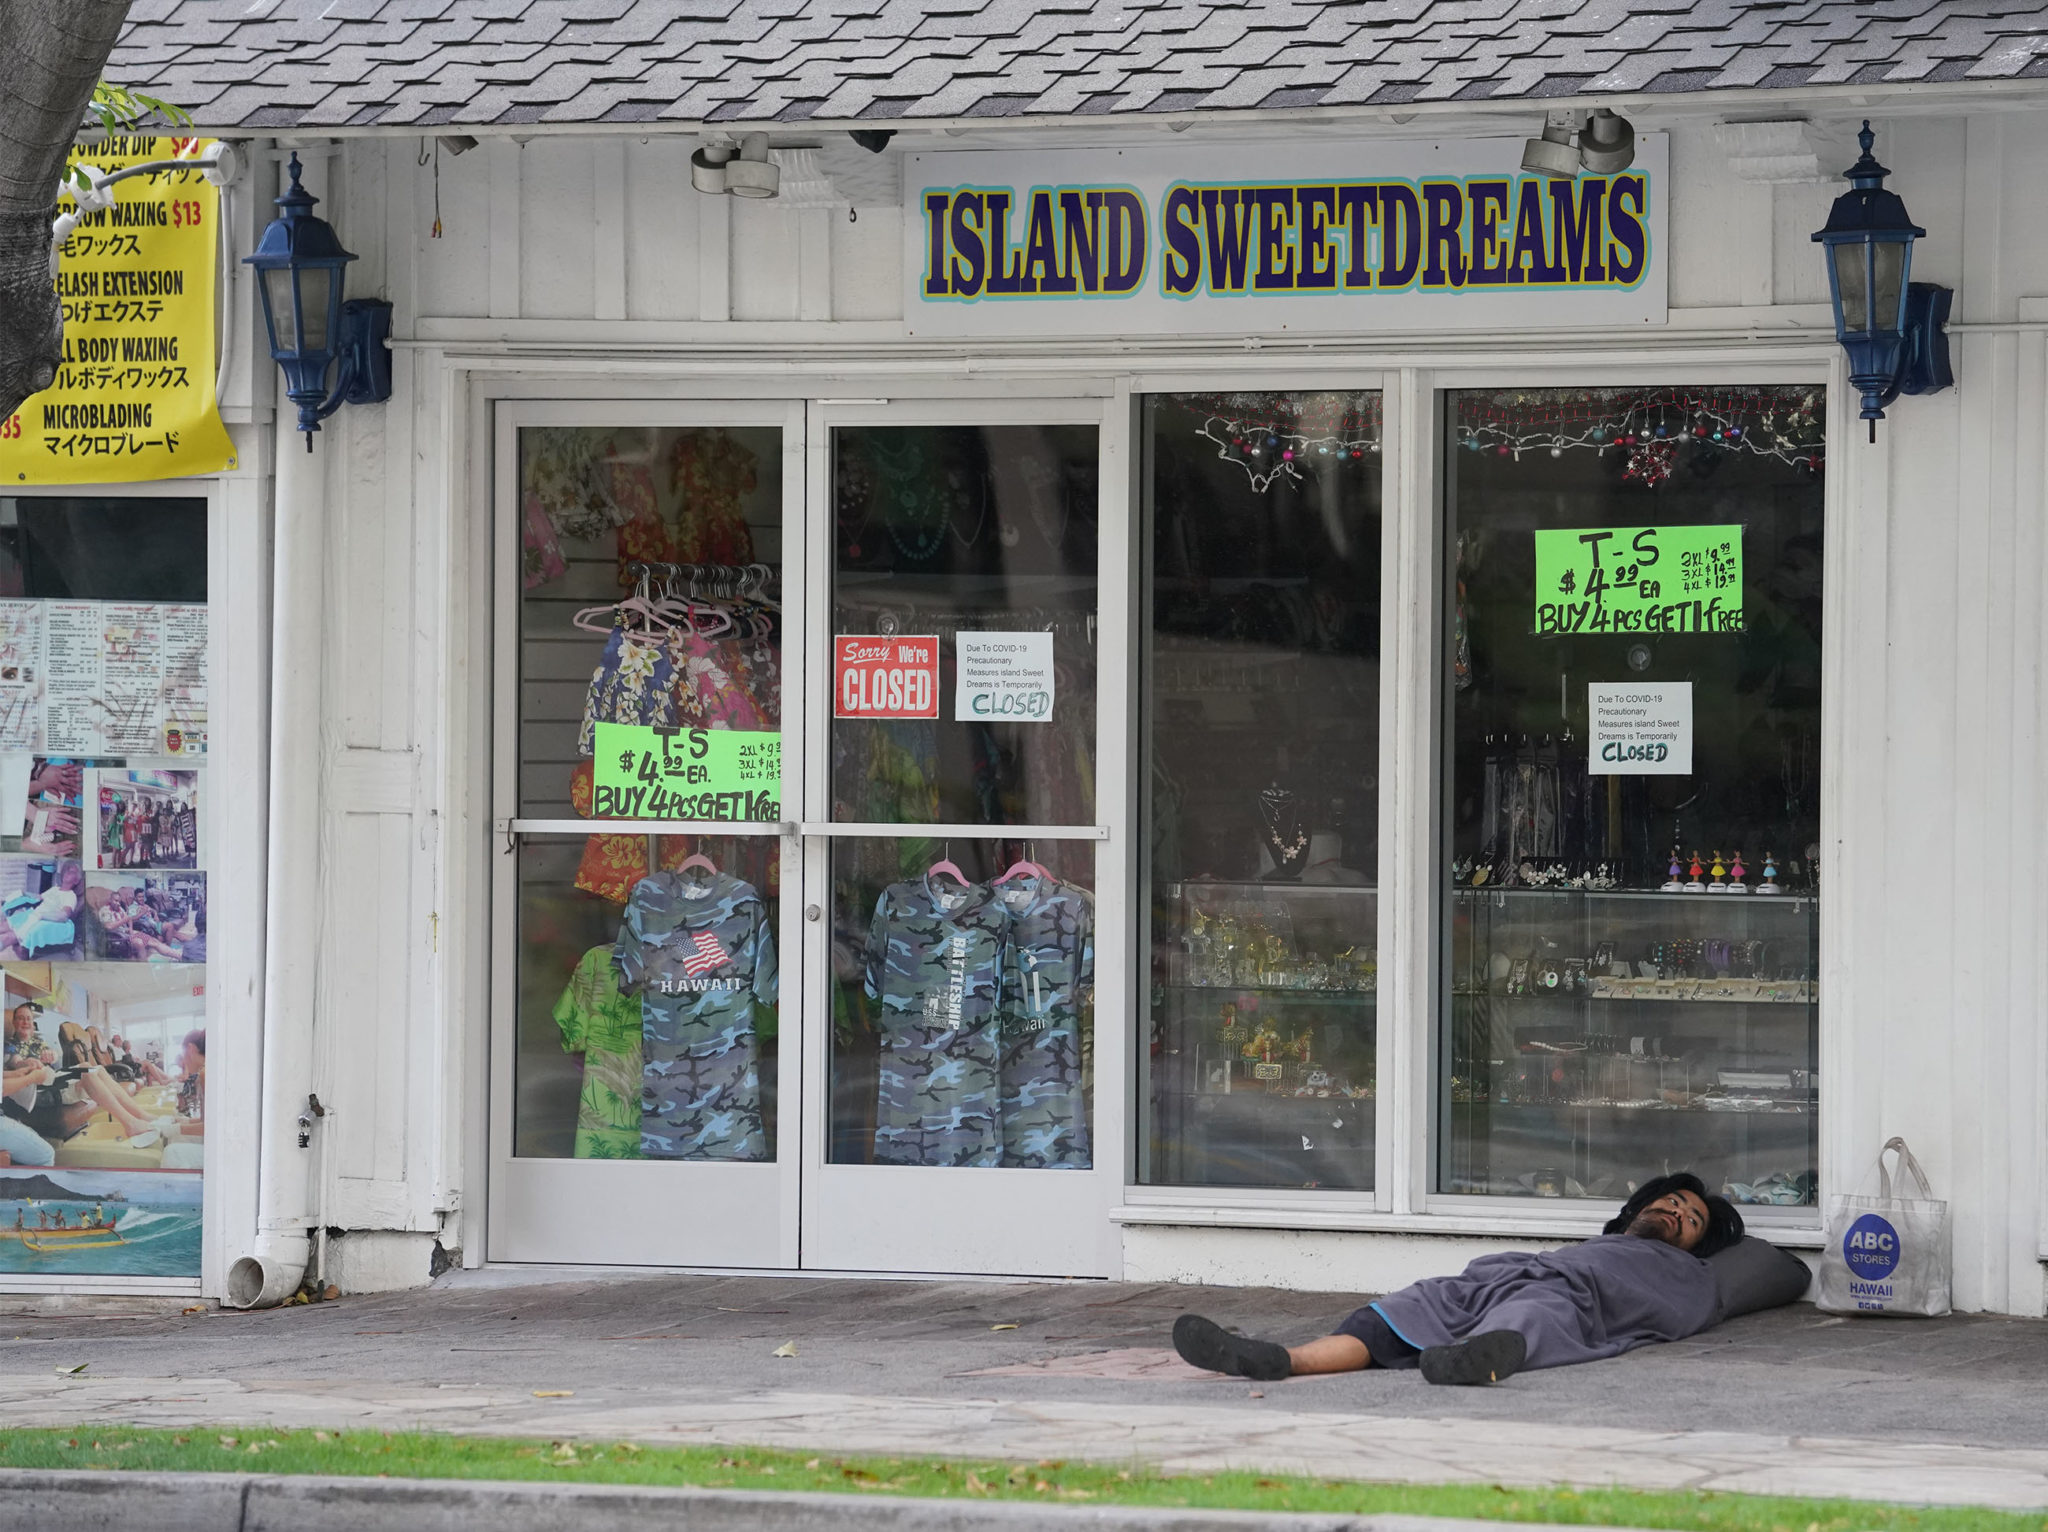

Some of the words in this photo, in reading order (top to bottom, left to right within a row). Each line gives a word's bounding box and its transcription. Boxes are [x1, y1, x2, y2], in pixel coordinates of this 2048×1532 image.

[131, 136, 156, 156] DIP
[110, 201, 167, 228] WAXING
[172, 199, 201, 228] $13
[921, 187, 1149, 297] ISLAND
[1162, 174, 1648, 294] SWEETDREAMS
[103, 270, 183, 296] EXTENSION
[78, 338, 119, 362] BODY
[122, 336, 178, 361] WAXING
[59, 366, 190, 390] ルボディワックス
[43, 403, 152, 429] MICROBLADING
[44, 432, 179, 457] マイクロブレード
[1578, 529, 1660, 568] T-S
[1681, 551, 1703, 567] 2XL
[1681, 567, 1704, 581] 3XL
[1640, 579, 1661, 599] EA
[1683, 580, 1703, 594] 4XL
[1537, 601, 1590, 634] BUY
[843, 642, 893, 663] Sorry
[898, 645, 929, 664] We're
[966, 644, 982, 653] Due
[983, 644, 993, 653] To
[993, 644, 1027, 653] COVID-19
[966, 656, 1013, 666] Precautionary
[966, 668, 1000, 678] Measures
[1022, 669, 1044, 678] Sweet
[842, 667, 932, 712] CLOSED
[966, 680, 993, 689] Dreams
[994, 680, 1000, 689] is
[1000, 680, 1043, 691] Temporarily
[971, 691, 1050, 718] CLOSED
[1598, 695, 1613, 703] Due
[1614, 695, 1625, 704] To
[1625, 694, 1663, 703] COVID-19
[1598, 707, 1647, 717] Precautionary
[1598, 720, 1633, 728] Measures
[1657, 720, 1680, 728] Sweet
[653, 727, 709, 759] T-S
[1598, 732, 1626, 740] Dreams
[1627, 731, 1634, 740] is
[1635, 732, 1678, 742] Temporarily
[739, 745, 758, 757] 2XL
[1602, 741, 1669, 763] CLOSED
[739, 759, 757, 770] 3XL
[740, 771, 756, 780] 4XL
[594, 785, 647, 817] BUY
[660, 977, 741, 993] HAWAII
[948, 937, 967, 1030] BATTLESHIP
[1849, 1231, 1894, 1251] ABC
[1852, 1253, 1891, 1266] STORES
[1850, 1282, 1893, 1297] HAWAII
